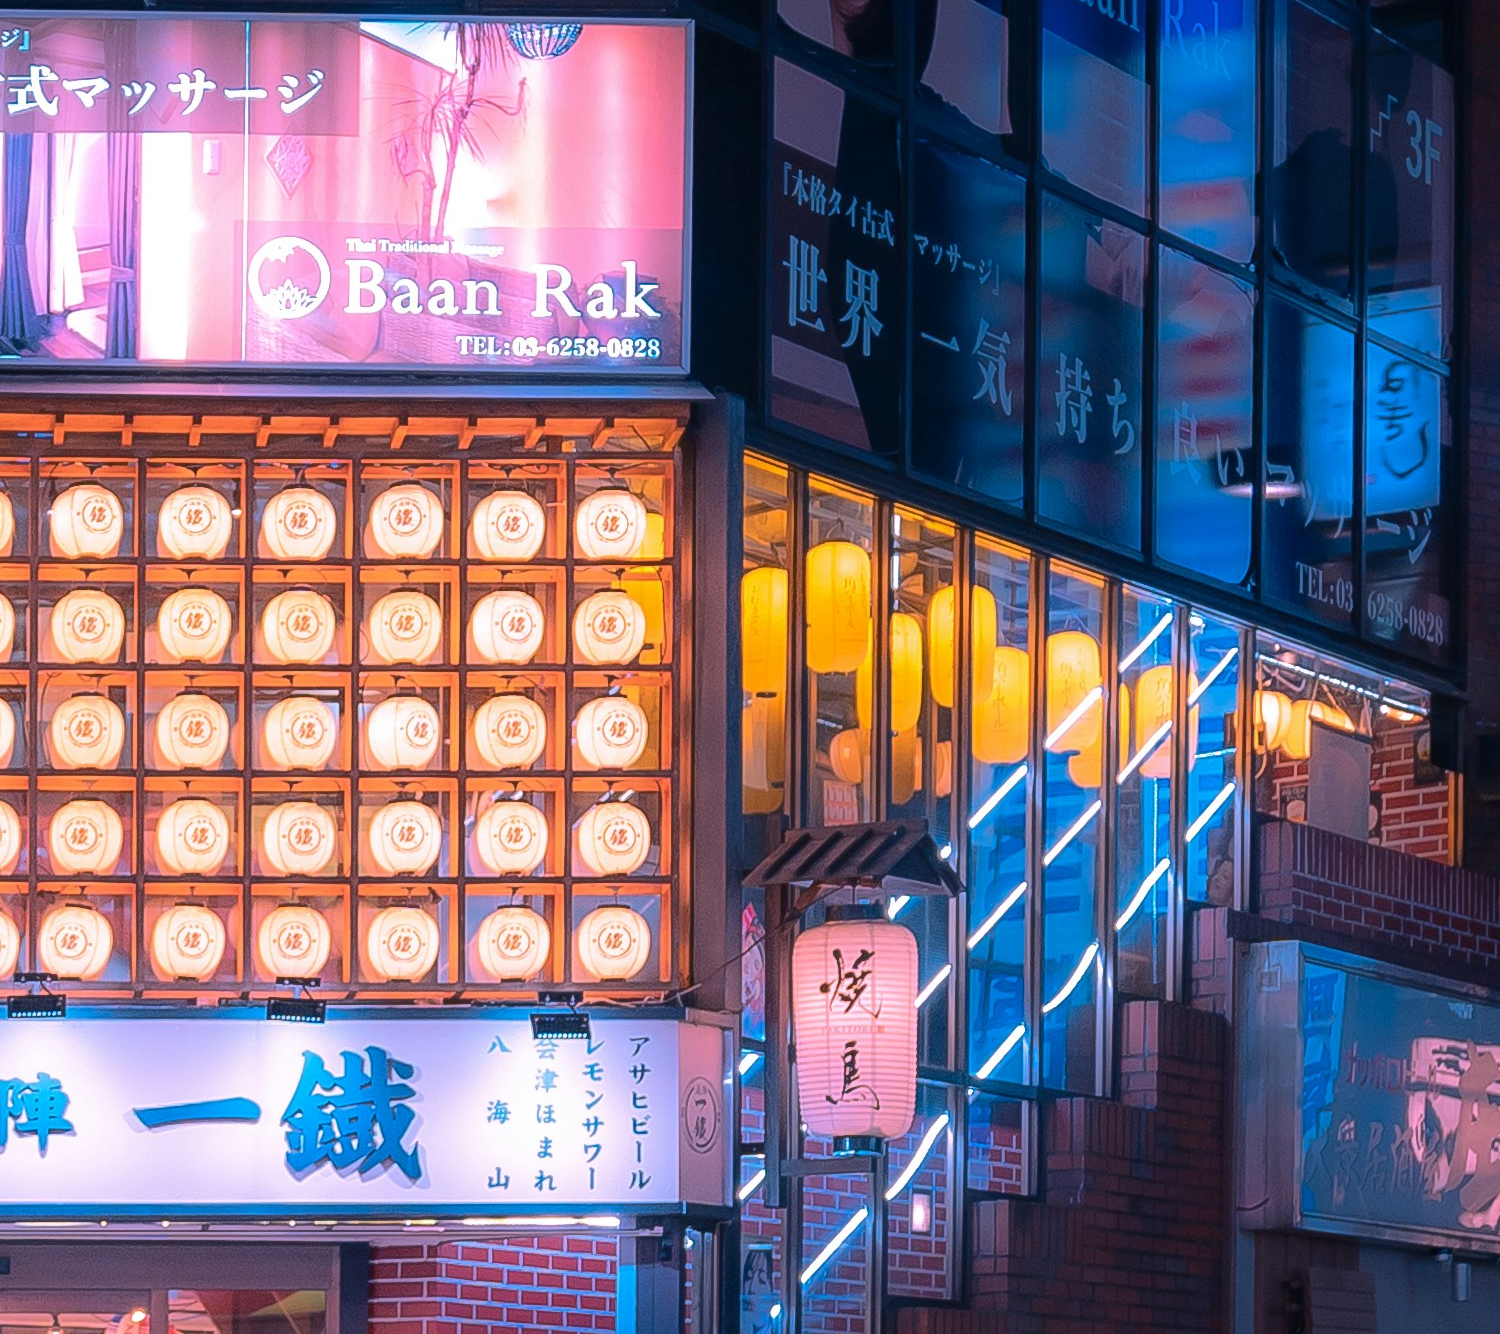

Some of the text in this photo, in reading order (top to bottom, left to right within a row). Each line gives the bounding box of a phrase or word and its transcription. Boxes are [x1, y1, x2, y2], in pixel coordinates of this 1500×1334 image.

[1404, 107, 1443, 188] 3F
[343, 259, 661, 319] Baan Rak
[346, 238, 376, 253] Thai
[377, 238, 450, 255] Traditional
[456, 335, 661, 358] TEL:03-6258-0828
[486, 1034, 512, 1190] 八海山
[533, 1038, 560, 1191] 会津ほまれ
[582, 1037, 605, 1190] レモンサワー
[628, 1035, 651, 1190] アサヒビール
